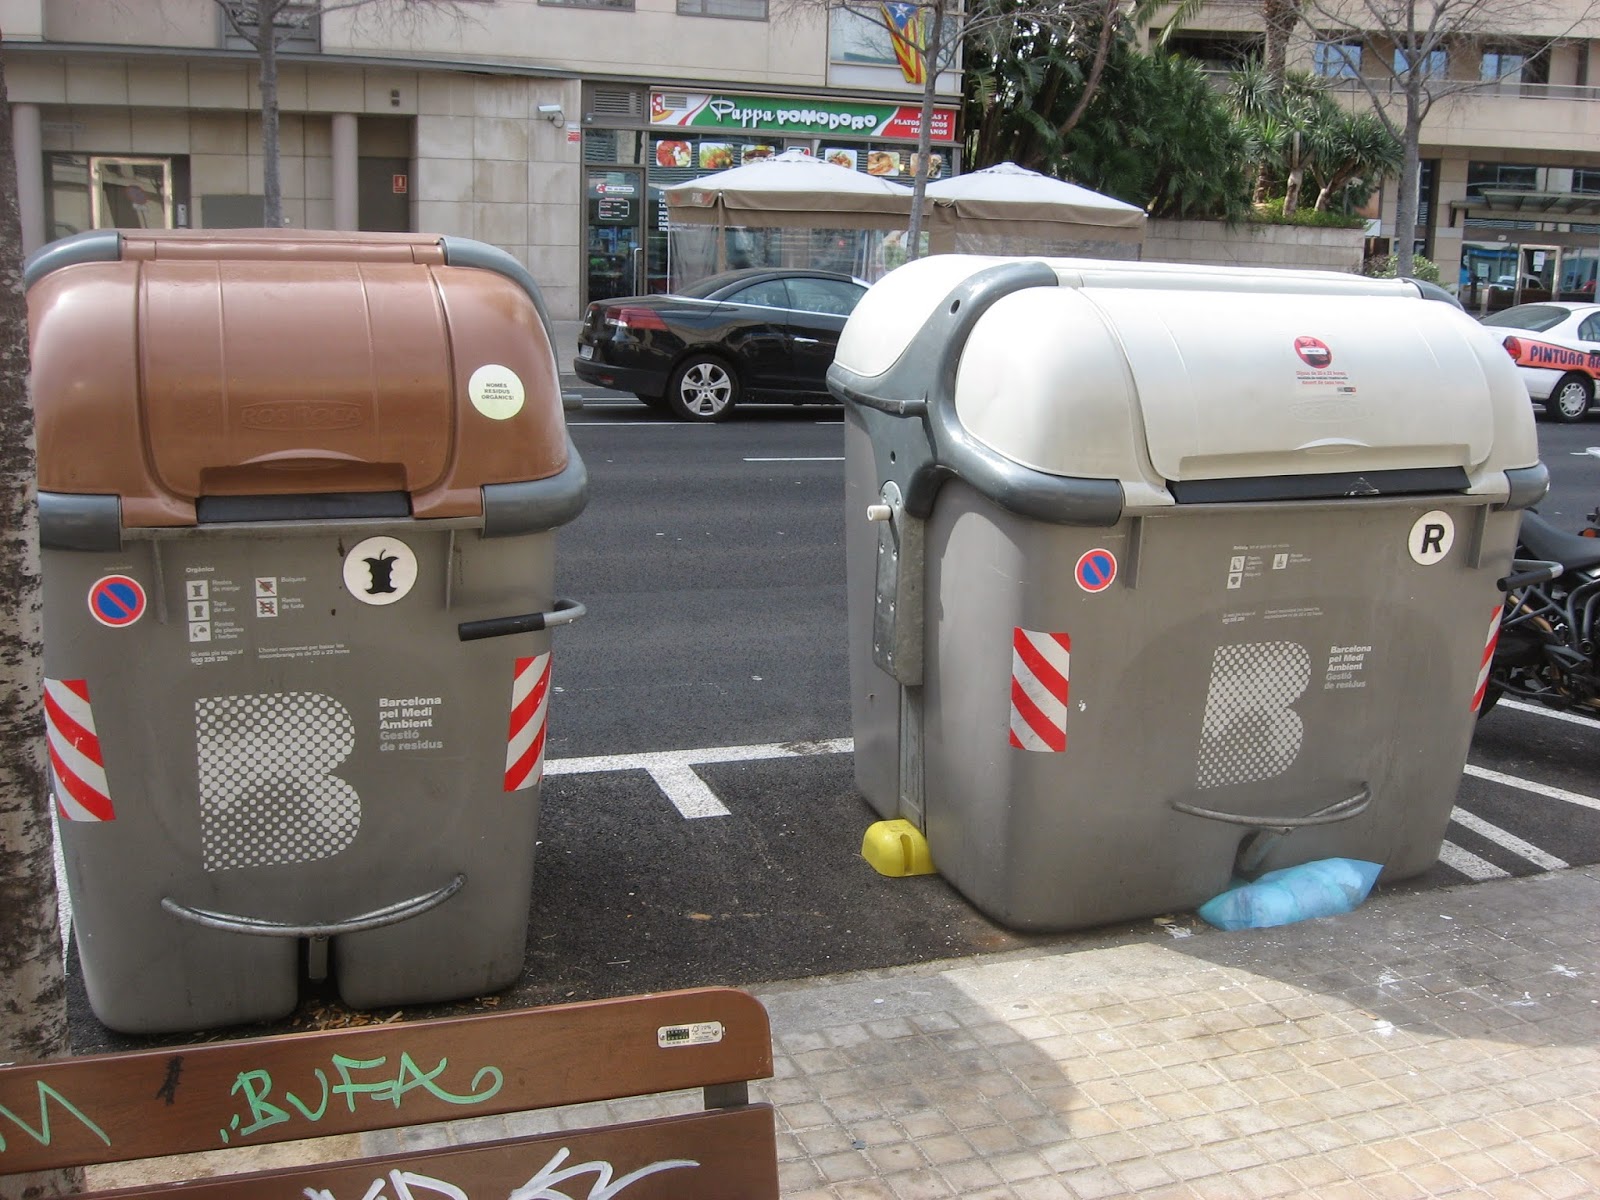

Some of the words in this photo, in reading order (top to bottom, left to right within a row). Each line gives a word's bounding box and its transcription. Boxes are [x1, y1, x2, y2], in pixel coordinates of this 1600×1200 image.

[709, 96, 775, 128] Pappa
[776, 109, 878, 130] POMODORO
[894, 118, 920, 126] PLATOS
[1530, 345, 1584, 366] PINTURA
[1421, 524, 1445, 553] R
[1330, 645, 1372, 653] Barcelona
[1329, 655, 1342, 664] pel
[1344, 653, 1364, 662] Medi
[1327, 662, 1363, 671] Ambient
[379, 697, 442, 707] Barcelona
[380, 708, 398, 720] pel
[402, 707, 432, 717] Medi
[380, 719, 433, 730] Ambient
[380, 730, 420, 740] Gestió
[380, 742, 396, 751] de
[399, 740, 443, 750] residus
